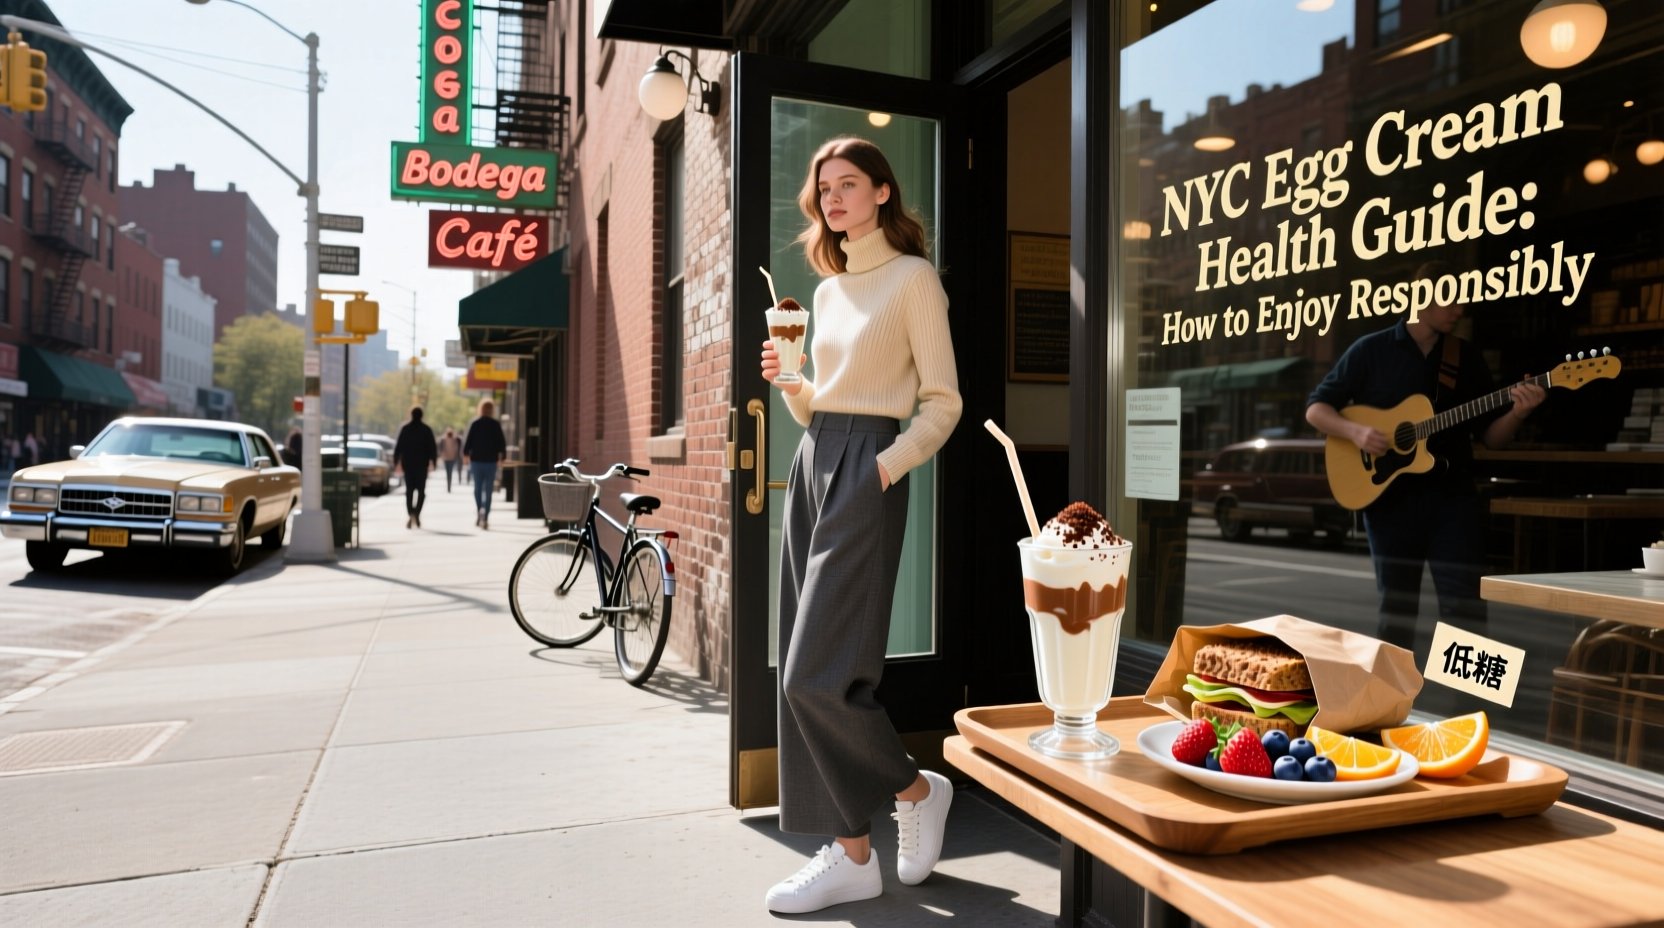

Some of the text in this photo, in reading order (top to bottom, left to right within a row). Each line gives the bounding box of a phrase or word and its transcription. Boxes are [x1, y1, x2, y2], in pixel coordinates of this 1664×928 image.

[401, 149, 546, 200] Bodega
[1160, 82, 1564, 237] NYC Egg Cream
[435, 217, 539, 267] Café
[1195, 170, 1538, 292] Health Guide:
[1161, 240, 1596, 345] How to Enjoy Responsibly
[1442, 640, 1509, 691] 低糖
